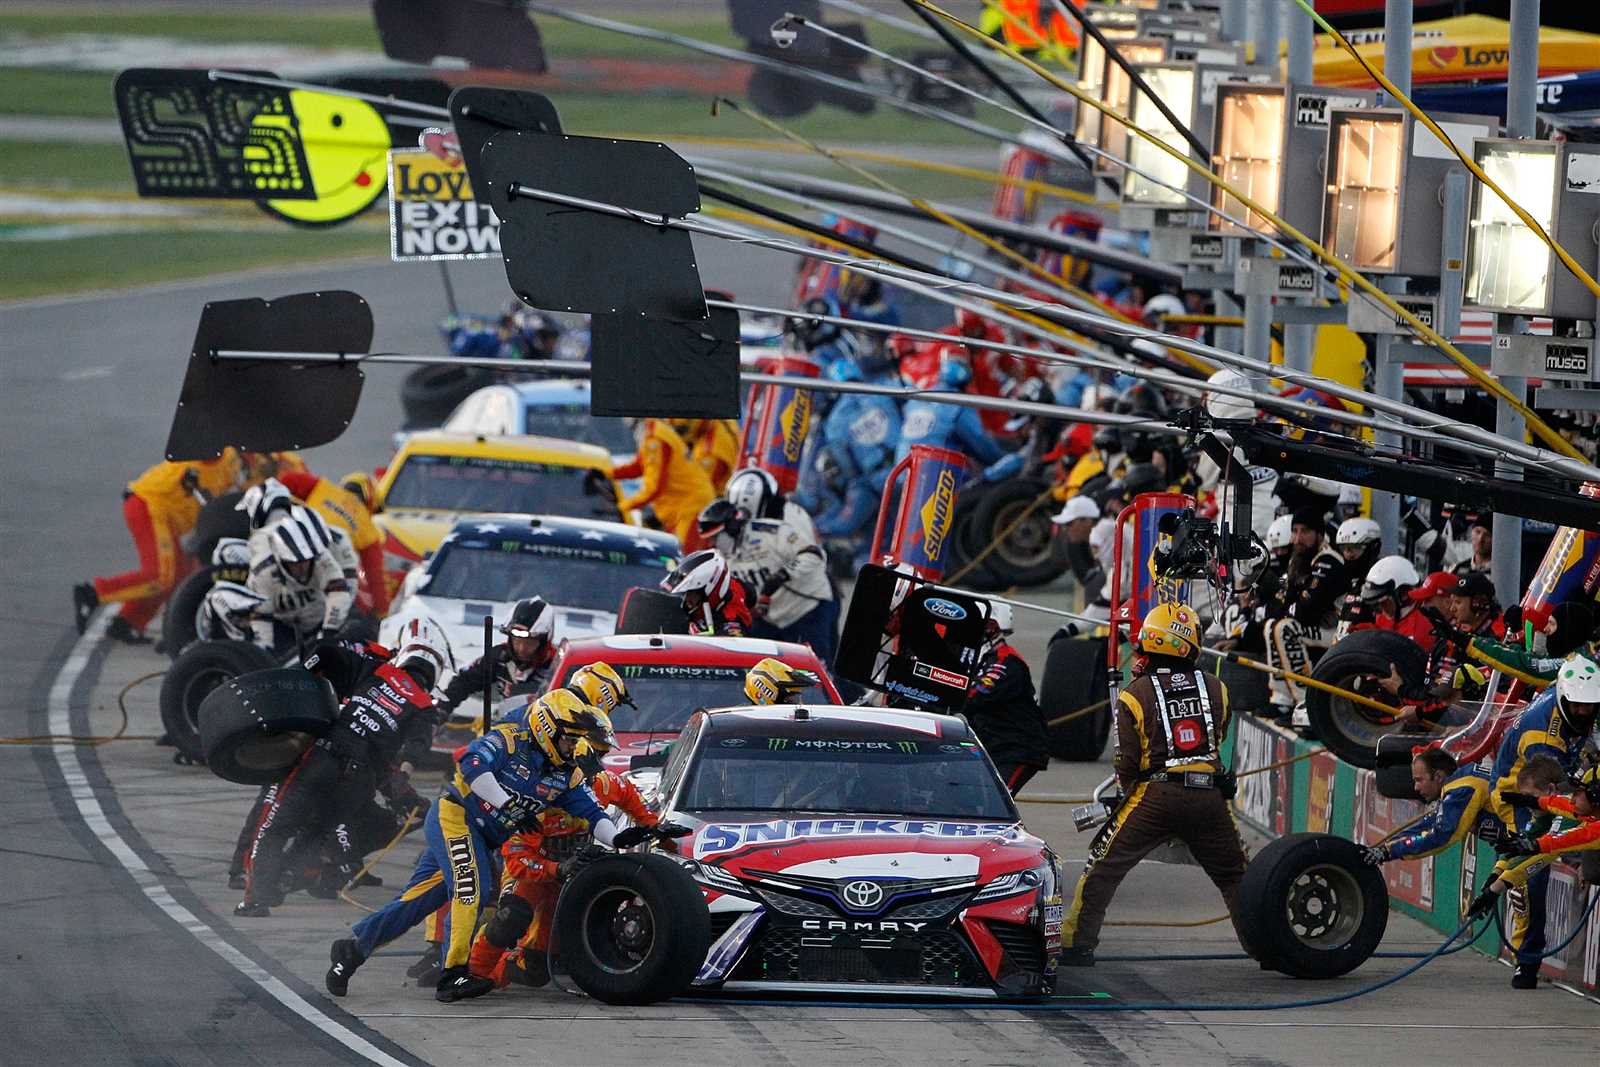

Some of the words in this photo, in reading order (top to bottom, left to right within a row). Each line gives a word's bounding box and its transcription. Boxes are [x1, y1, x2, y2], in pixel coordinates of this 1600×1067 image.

[926, 472, 954, 560] SUNOCO
[931, 602, 958, 617] Ford
[649, 667, 738, 677] MONSTER
[352, 705, 381, 732] FORD
[795, 740, 892, 750] MONSTER
[700, 821, 1017, 853] SNICKERS
[801, 920, 928, 932] CAMRY
